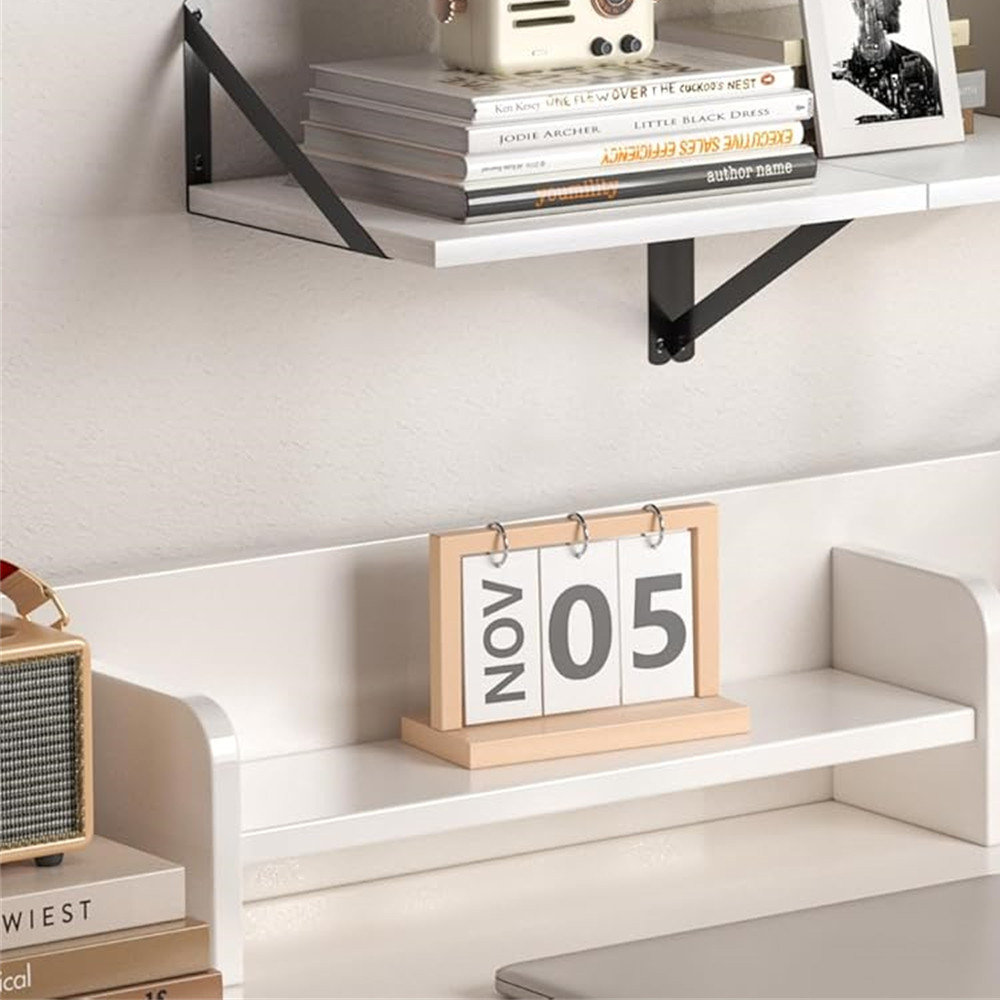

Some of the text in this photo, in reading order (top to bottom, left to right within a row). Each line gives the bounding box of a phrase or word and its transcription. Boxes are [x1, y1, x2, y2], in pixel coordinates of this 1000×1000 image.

[611, 85, 649, 101] OVER
[652, 82, 676, 96] THE
[727, 78, 757, 91] NEST
[633, 107, 771, 130] LITTLE BLACK DRESS
[500, 126, 601, 145] JODIE ARCHER
[600, 128, 794, 167] EXECUTIVE SALES EFFICIENCY
[706, 160, 793, 184] author name
[548, 572, 688, 681] 05
[481, 579, 526, 705] NOV
[2, 900, 92, 934] WIEST
